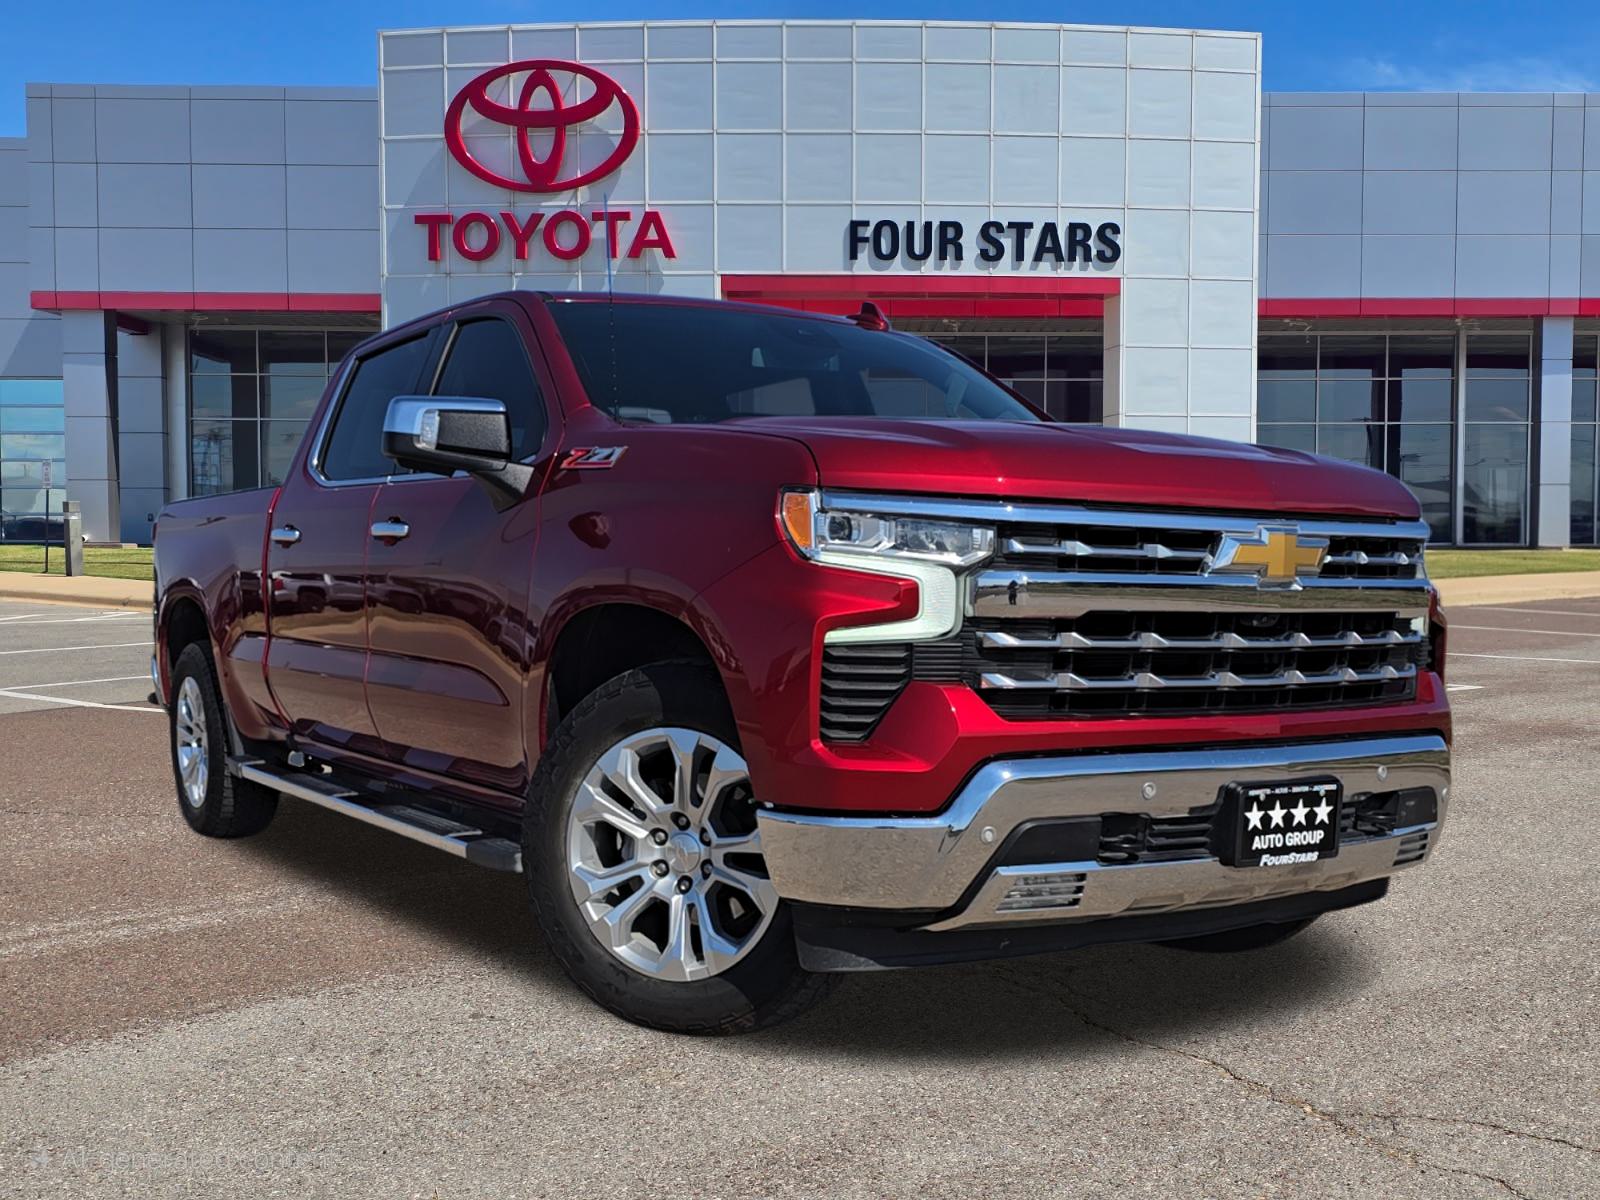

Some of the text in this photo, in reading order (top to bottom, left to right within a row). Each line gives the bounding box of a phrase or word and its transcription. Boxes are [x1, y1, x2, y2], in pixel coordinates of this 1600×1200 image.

[414, 210, 677, 262] TOYOTA
[849, 219, 1122, 264] FOUR STARS
[1252, 830, 1324, 850] AUTO GROUP
